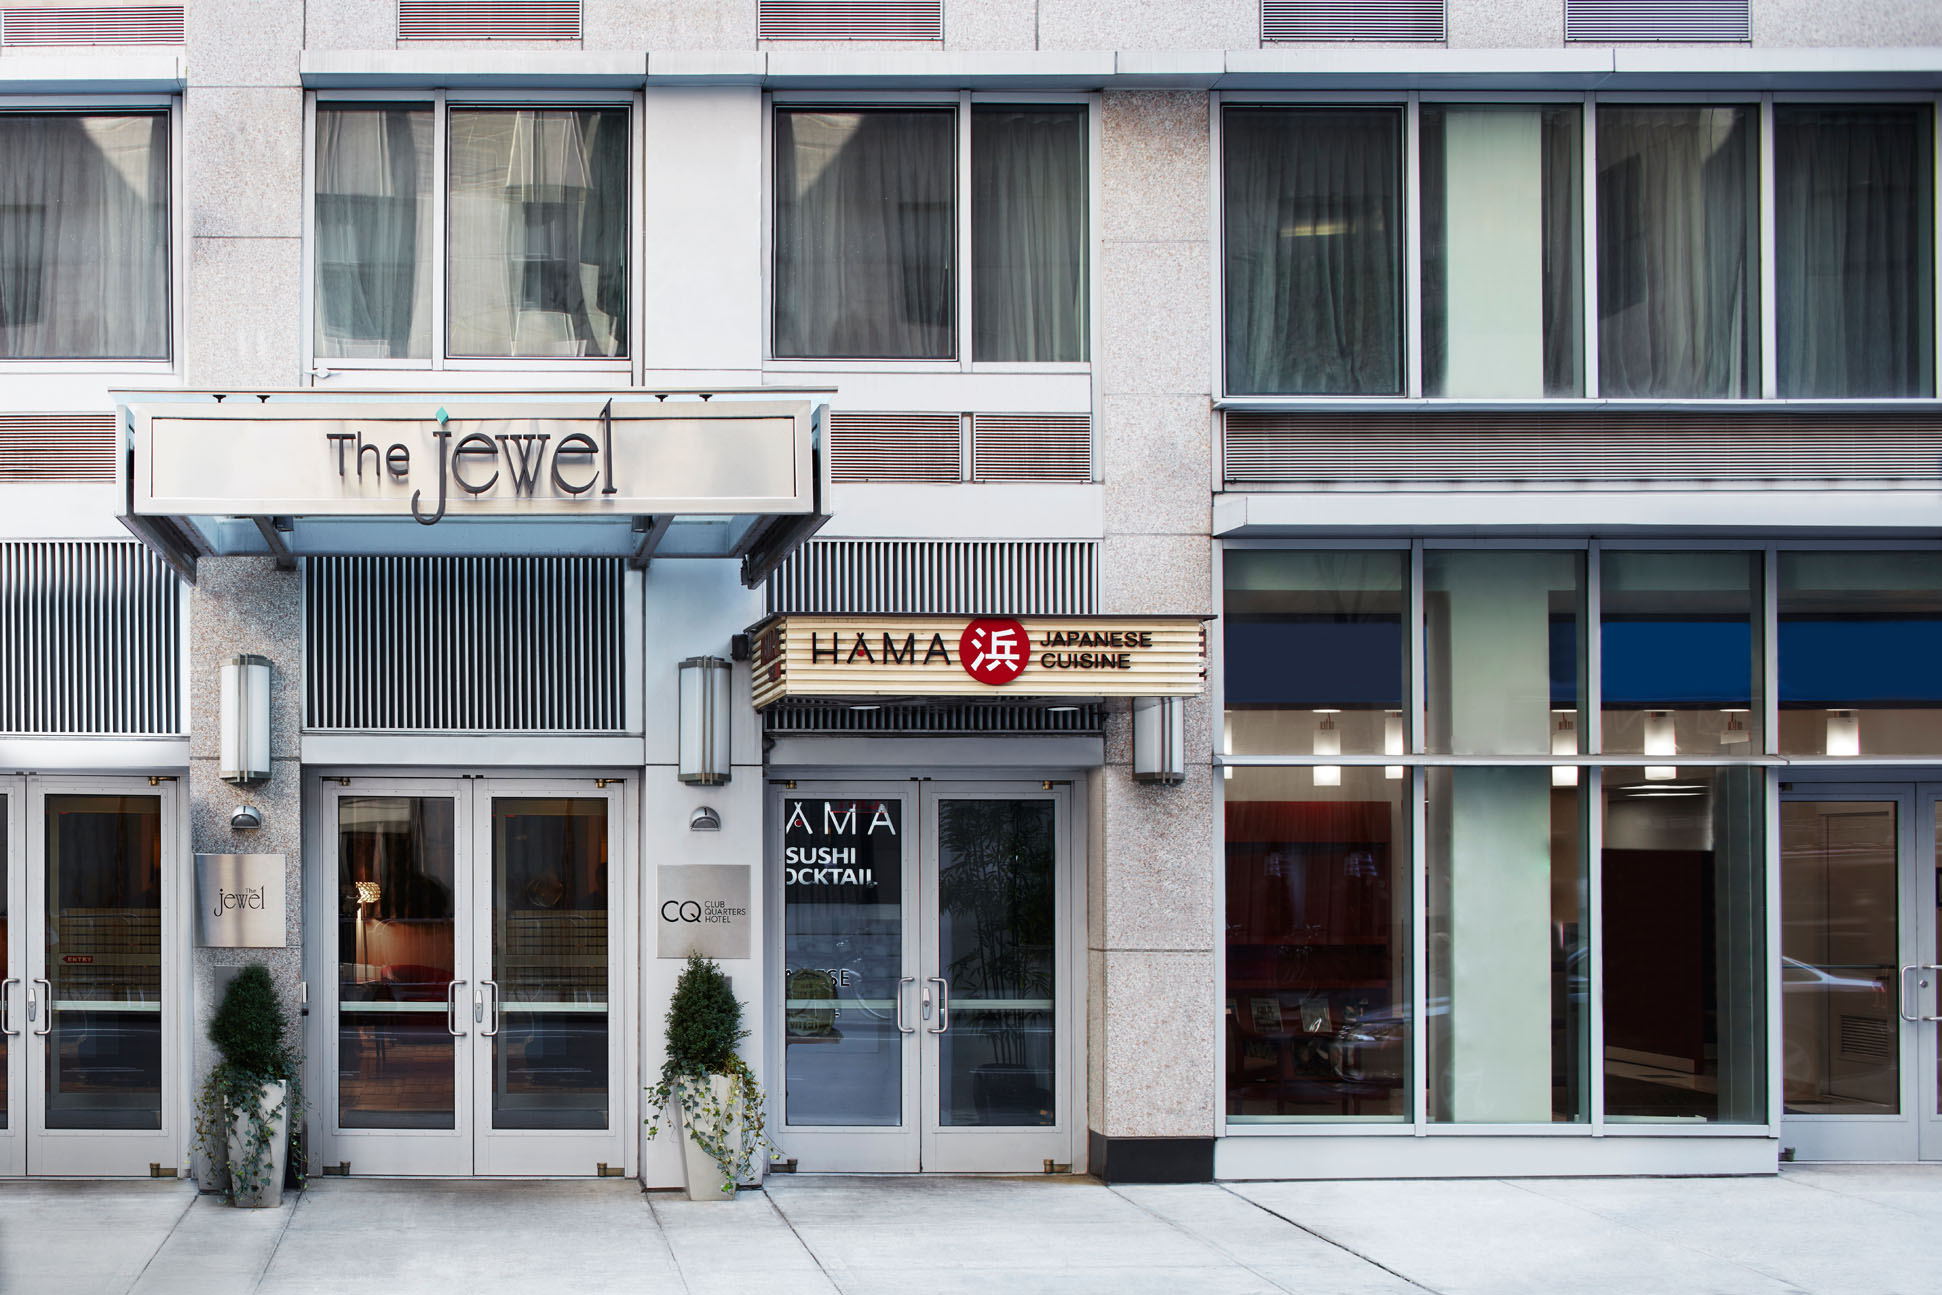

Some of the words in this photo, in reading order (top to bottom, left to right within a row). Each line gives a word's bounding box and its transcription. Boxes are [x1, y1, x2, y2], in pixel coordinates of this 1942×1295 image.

[326, 431, 410, 477] The
[411, 397, 618, 526] jewel
[811, 631, 951, 666] HAMA
[1040, 631, 1153, 648] JAPANESE
[970, 627, 1020, 672] 浜
[1040, 652, 1132, 669] CUISINE
[785, 846, 856, 865] SUSHI
[213, 885, 265, 917] jewel
[704, 900, 726, 909] CLUB
[661, 900, 702, 923] CQ
[704, 908, 747, 916] QUARTERS
[704, 915, 732, 924] HOTEL
